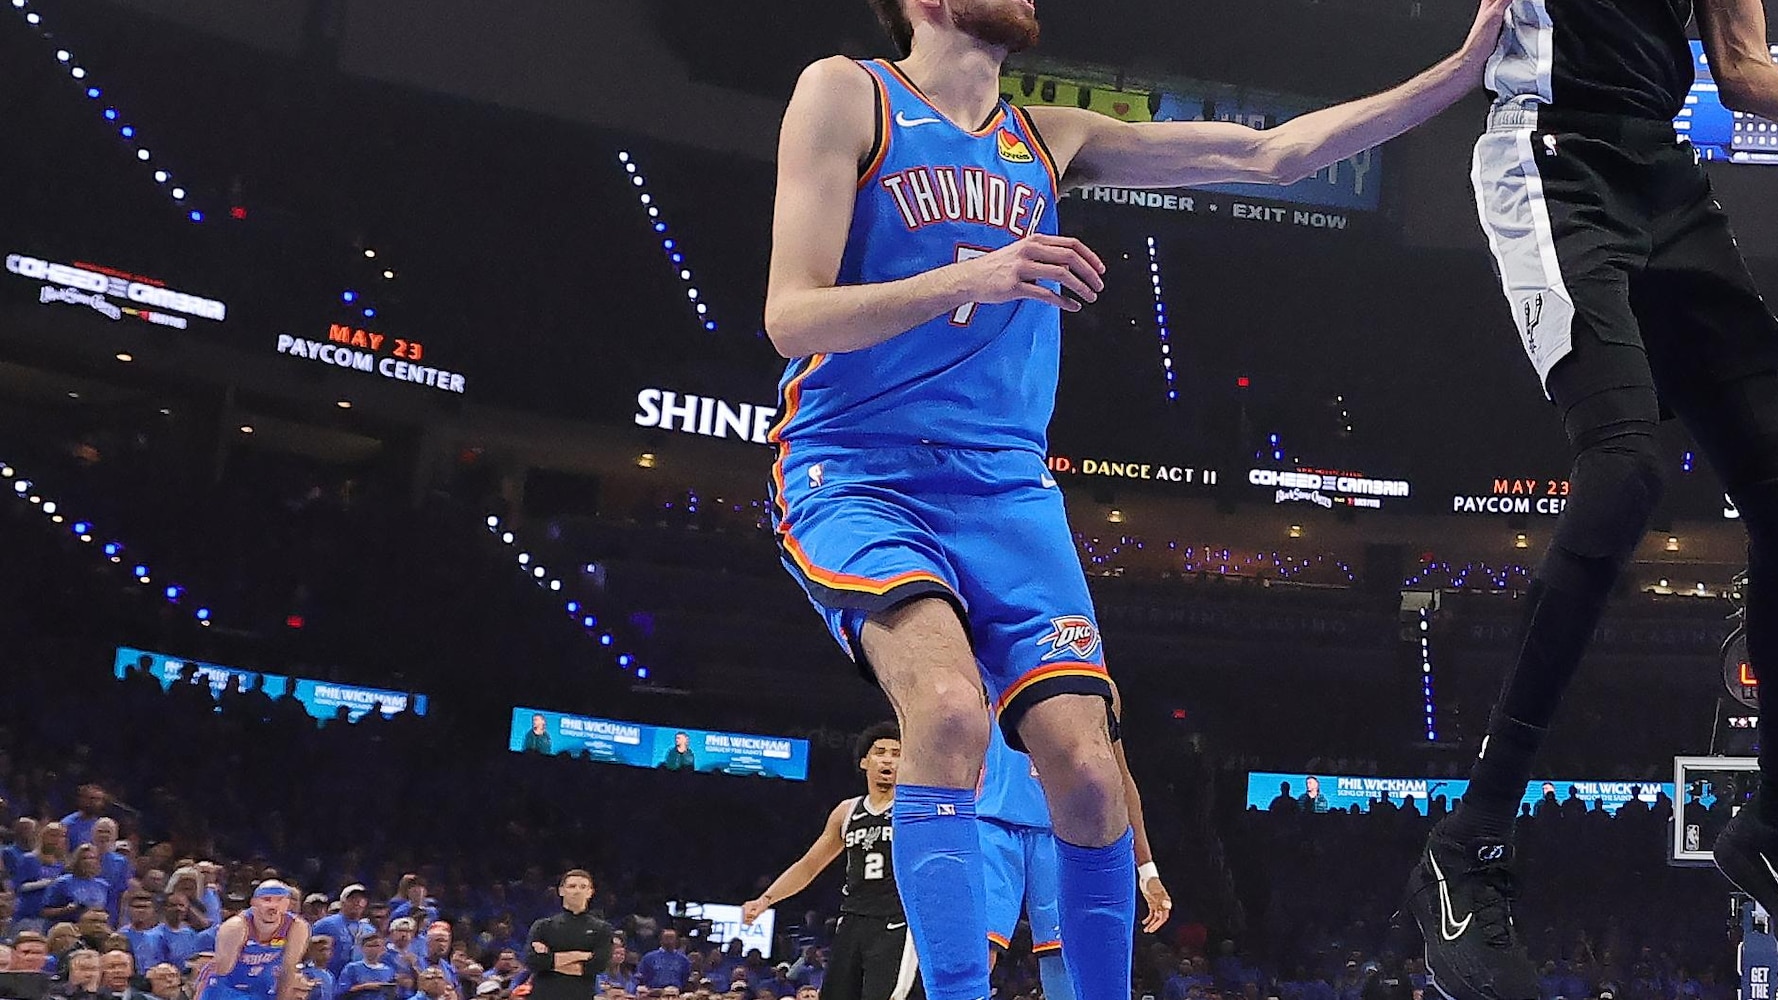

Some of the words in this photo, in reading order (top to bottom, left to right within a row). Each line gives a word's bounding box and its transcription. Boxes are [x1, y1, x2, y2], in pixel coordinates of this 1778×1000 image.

[884, 167, 1047, 238] THUNDER
[1080, 186, 1195, 213] THUNDER
[1232, 203, 1288, 225] EXIT
[1293, 209, 1349, 231] NOW
[329, 323, 384, 351] MAY
[392, 337, 424, 361] 23
[277, 333, 374, 374] PAYCOM
[378, 357, 466, 394] CENTER
[1082, 459, 1151, 481] DANCE
[1156, 465, 1194, 484] ACT
[1203, 470, 1217, 485] II
[1249, 469, 1323, 490] COHEED
[1493, 479, 1539, 495] MAY
[1454, 496, 1531, 514] PAYCOM
[560, 717, 584, 731] PHIL
[585, 720, 640, 737] WICKHAM
[705, 734, 729, 749] PHIL
[730, 737, 791, 751] WICKHAM
[1337, 778, 1363, 790] PHIL
[1363, 779, 1427, 791] WICKHAM
[1574, 782, 1599, 794] PHIL
[1599, 782, 1662, 795] WICKAM
[845, 827, 893, 850] SPUR
[864, 852, 885, 880] 2
[1749, 967, 1770, 984] GET
[1749, 982, 1770, 1000] THE
